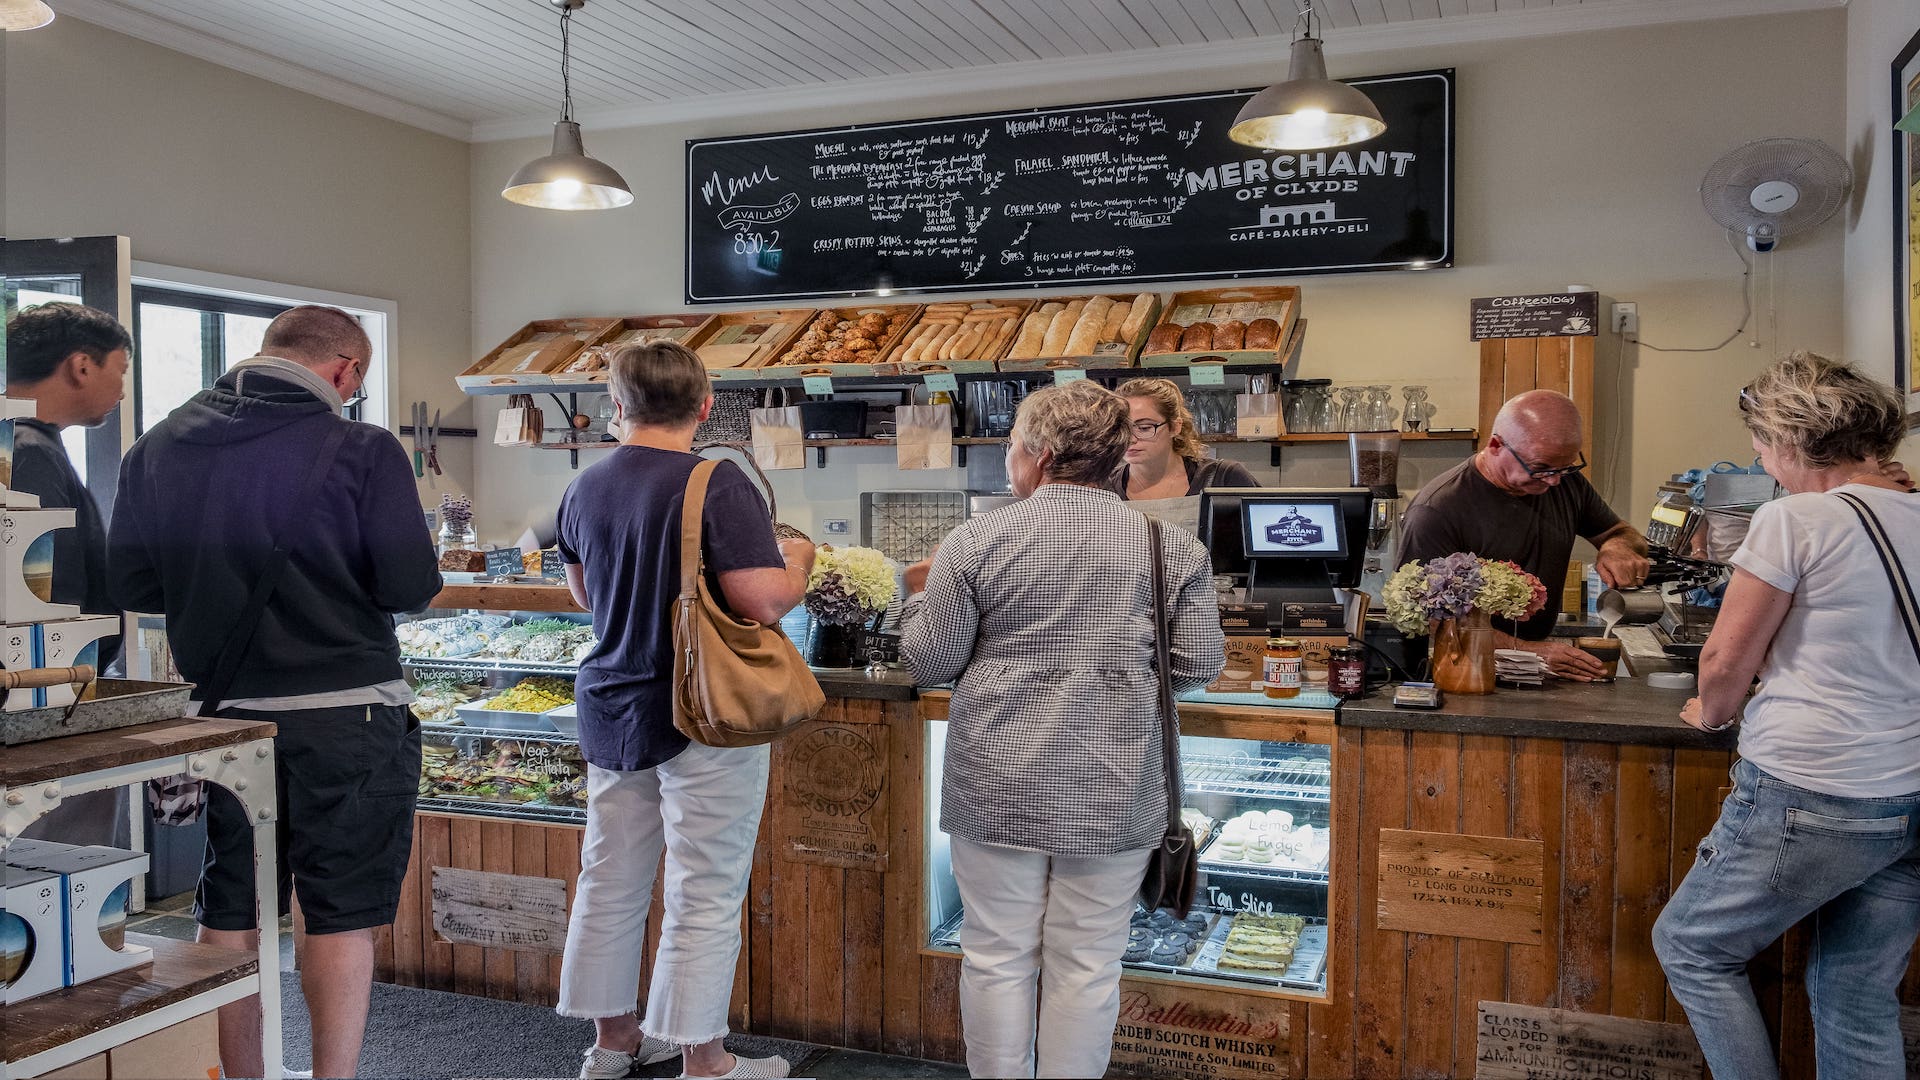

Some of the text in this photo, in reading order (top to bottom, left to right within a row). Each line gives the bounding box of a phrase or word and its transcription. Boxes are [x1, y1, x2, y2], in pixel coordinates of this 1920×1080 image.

[814, 143, 845, 157] MUESLI
[1015, 158, 1053, 173] FALAFEL
[1061, 151, 1111, 168] SANDWICH
[1185, 151, 1416, 196] MERCHANT
[701, 165, 779, 205] Menu
[1235, 179, 1360, 201] OF CLYDE
[811, 195, 832, 208] EGGS
[733, 201, 794, 220] AVAILABLE
[926, 210, 951, 218] BACON
[1004, 203, 1035, 216] CAESAR
[926, 216, 956, 225] SALMON
[1122, 217, 1153, 227] CHICKEN
[923, 225, 957, 233] ASPARAGUS
[813, 239, 842, 250] CRISPY
[844, 237, 875, 249] POTATO
[878, 235, 902, 247] SKINS
[960, 261, 973, 272] $21
[1024, 266, 1034, 277] 3
[406, 617, 468, 632] Mousetrap
[865, 636, 888, 648] BITE
[860, 647, 895, 660] TRAT
[1270, 662, 1300, 673] PEANUT
[412, 668, 457, 683] Chickpea
[517, 740, 550, 763] Vege
[796, 781, 878, 816] GASOLINE
[1248, 818, 1293, 834] Lemo
[842, 841, 859, 851] OIL
[1257, 834, 1304, 857] Fudge
[1386, 863, 1536, 887] PRODUCT OF SCOTLAND
[1407, 879, 1513, 898] 12 LONG QUARTS
[1206, 886, 1275, 918] Tan Slice
[441, 915, 549, 944] COMPANY LIMITED
[1484, 1014, 1528, 1029] CLASS
[1112, 1024, 1276, 1057] ENDED SCOTCH WHISKY
[1492, 1026, 1549, 1042] LOADED
[1519, 1042, 1542, 1053] FOR
[1112, 1041, 1133, 1052] RGE
[1134, 1042, 1195, 1061] BALLANTINE
[1196, 1053, 1206, 1063] &
[1231, 1056, 1276, 1073] LIMITED
[1483, 1049, 1592, 1073] AMMUNITION
[1147, 1056, 1218, 1074] DISTILLERS
